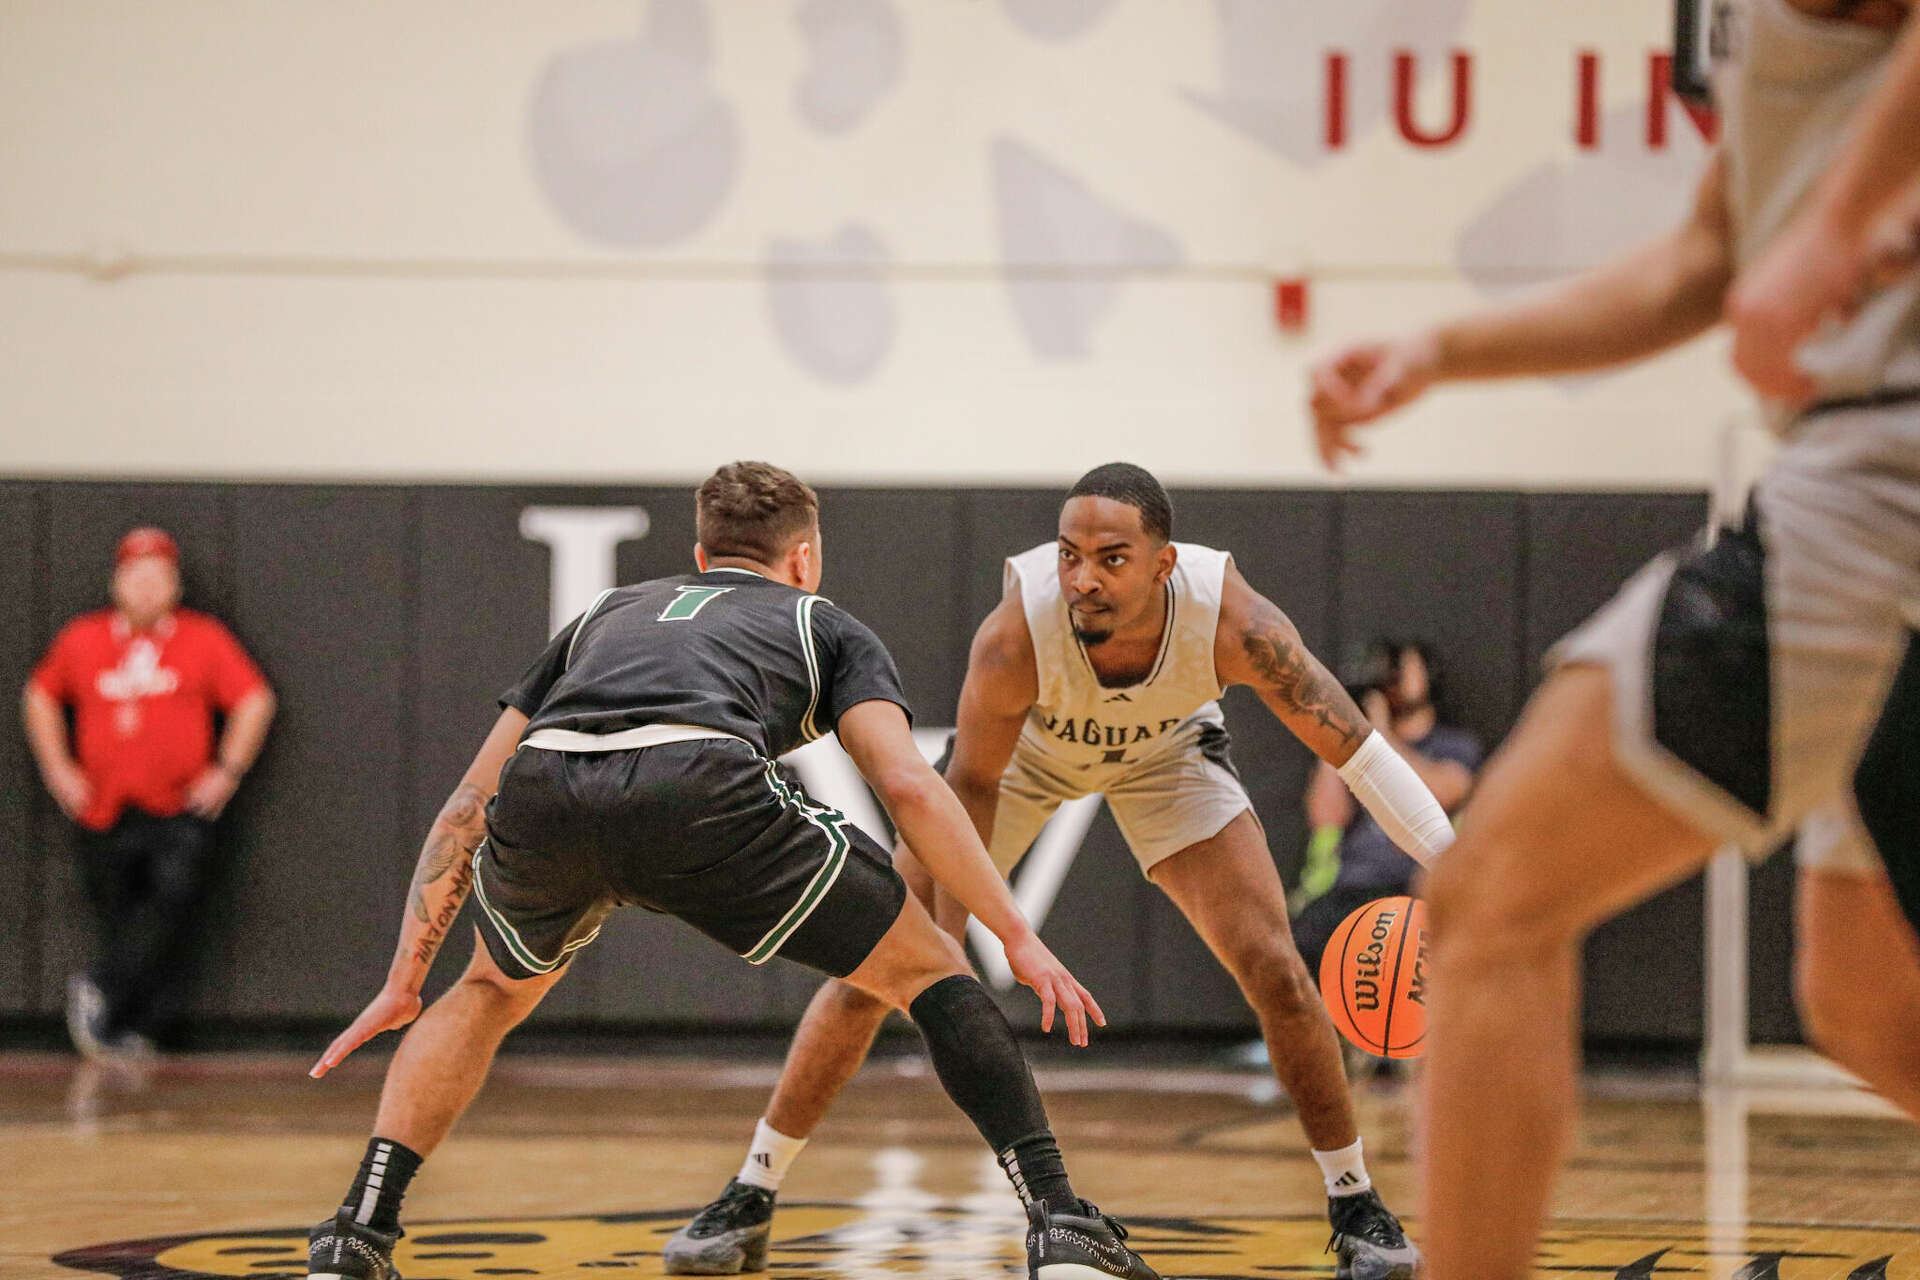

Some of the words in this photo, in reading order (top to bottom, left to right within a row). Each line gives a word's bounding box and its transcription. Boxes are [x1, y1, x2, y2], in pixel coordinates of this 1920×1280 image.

[1323, 51, 1473, 151] IU
[656, 585, 737, 622] 7
[1355, 911, 1398, 1012] Wilson
